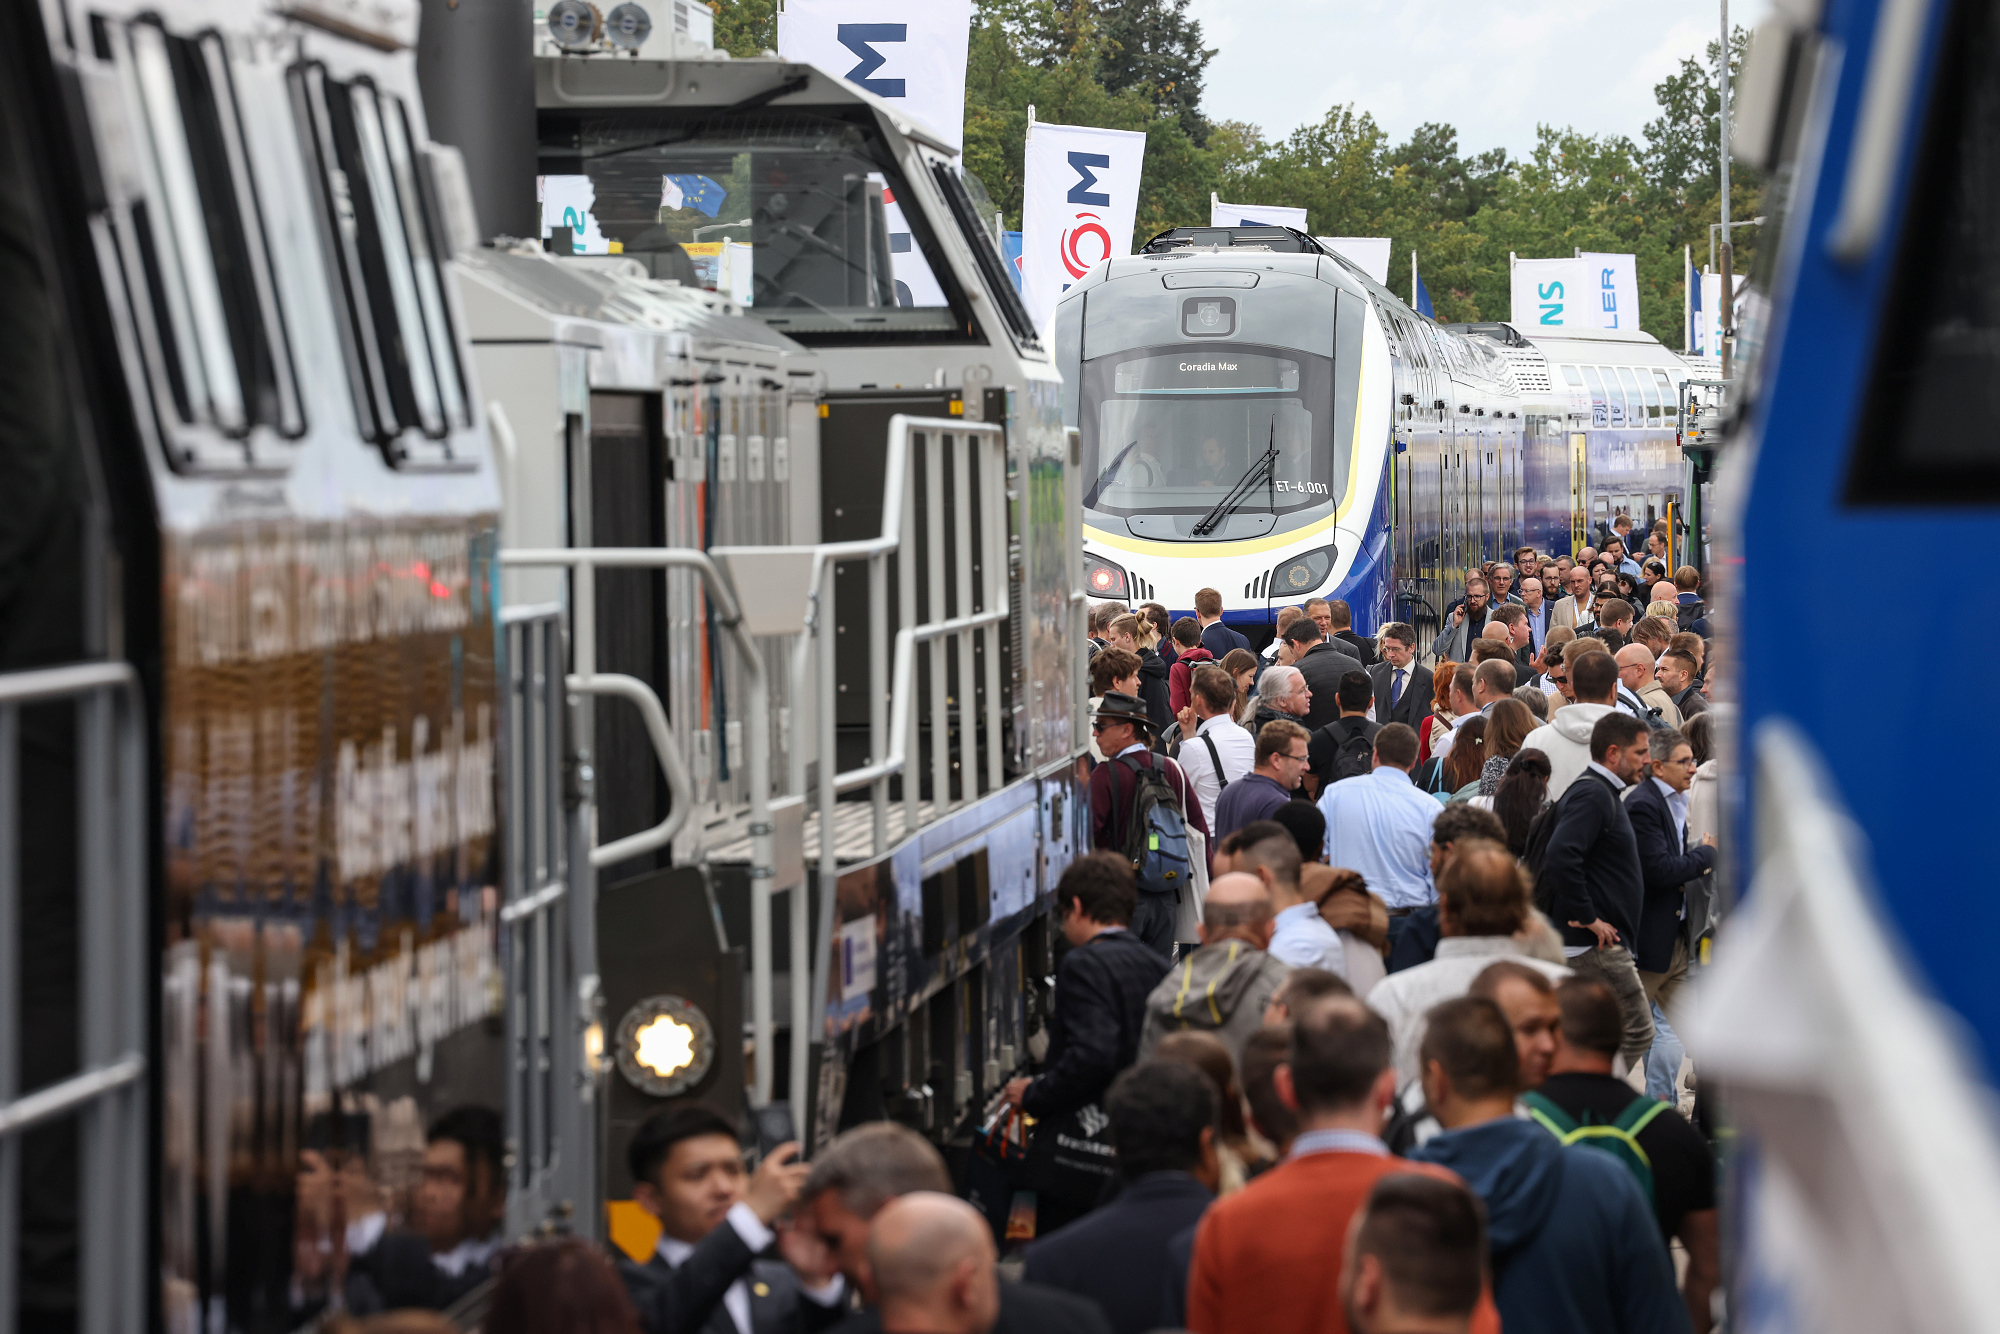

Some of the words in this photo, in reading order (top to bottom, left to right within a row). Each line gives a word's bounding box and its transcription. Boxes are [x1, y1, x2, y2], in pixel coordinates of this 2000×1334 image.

[837, 23, 907, 98] M
[1061, 151, 1111, 292] OM
[1538, 281, 1564, 325] NS
[1601, 268, 1618, 329] LER
[1179, 362, 1216, 372] Coradia
[1218, 362, 1238, 371] Max
[1275, 480, 1329, 495] ET-6.001
